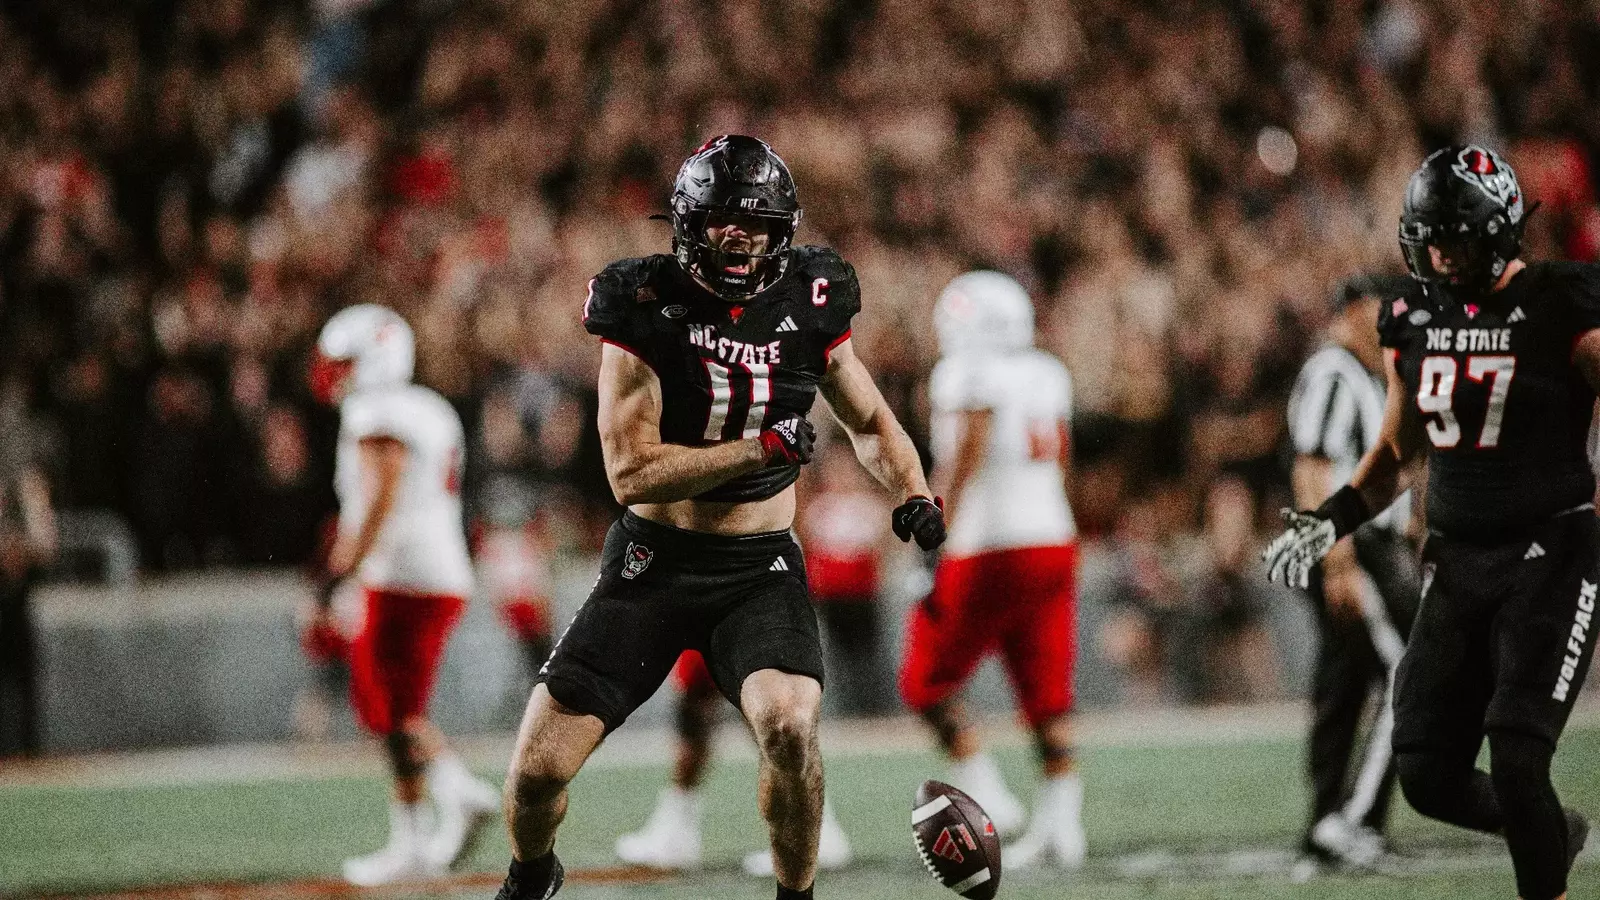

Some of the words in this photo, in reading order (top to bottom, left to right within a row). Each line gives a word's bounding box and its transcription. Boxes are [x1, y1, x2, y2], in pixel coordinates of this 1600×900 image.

[740, 197, 759, 209] HTT
[811, 277, 829, 306] C
[686, 323, 717, 350] NC
[717, 338, 781, 365] STATE
[1426, 328, 1452, 351] NC
[1455, 328, 1512, 352] STATE
[703, 358, 773, 441] 11
[1417, 354, 1516, 448] 97
[1551, 577, 1598, 703] WOLFPACK
